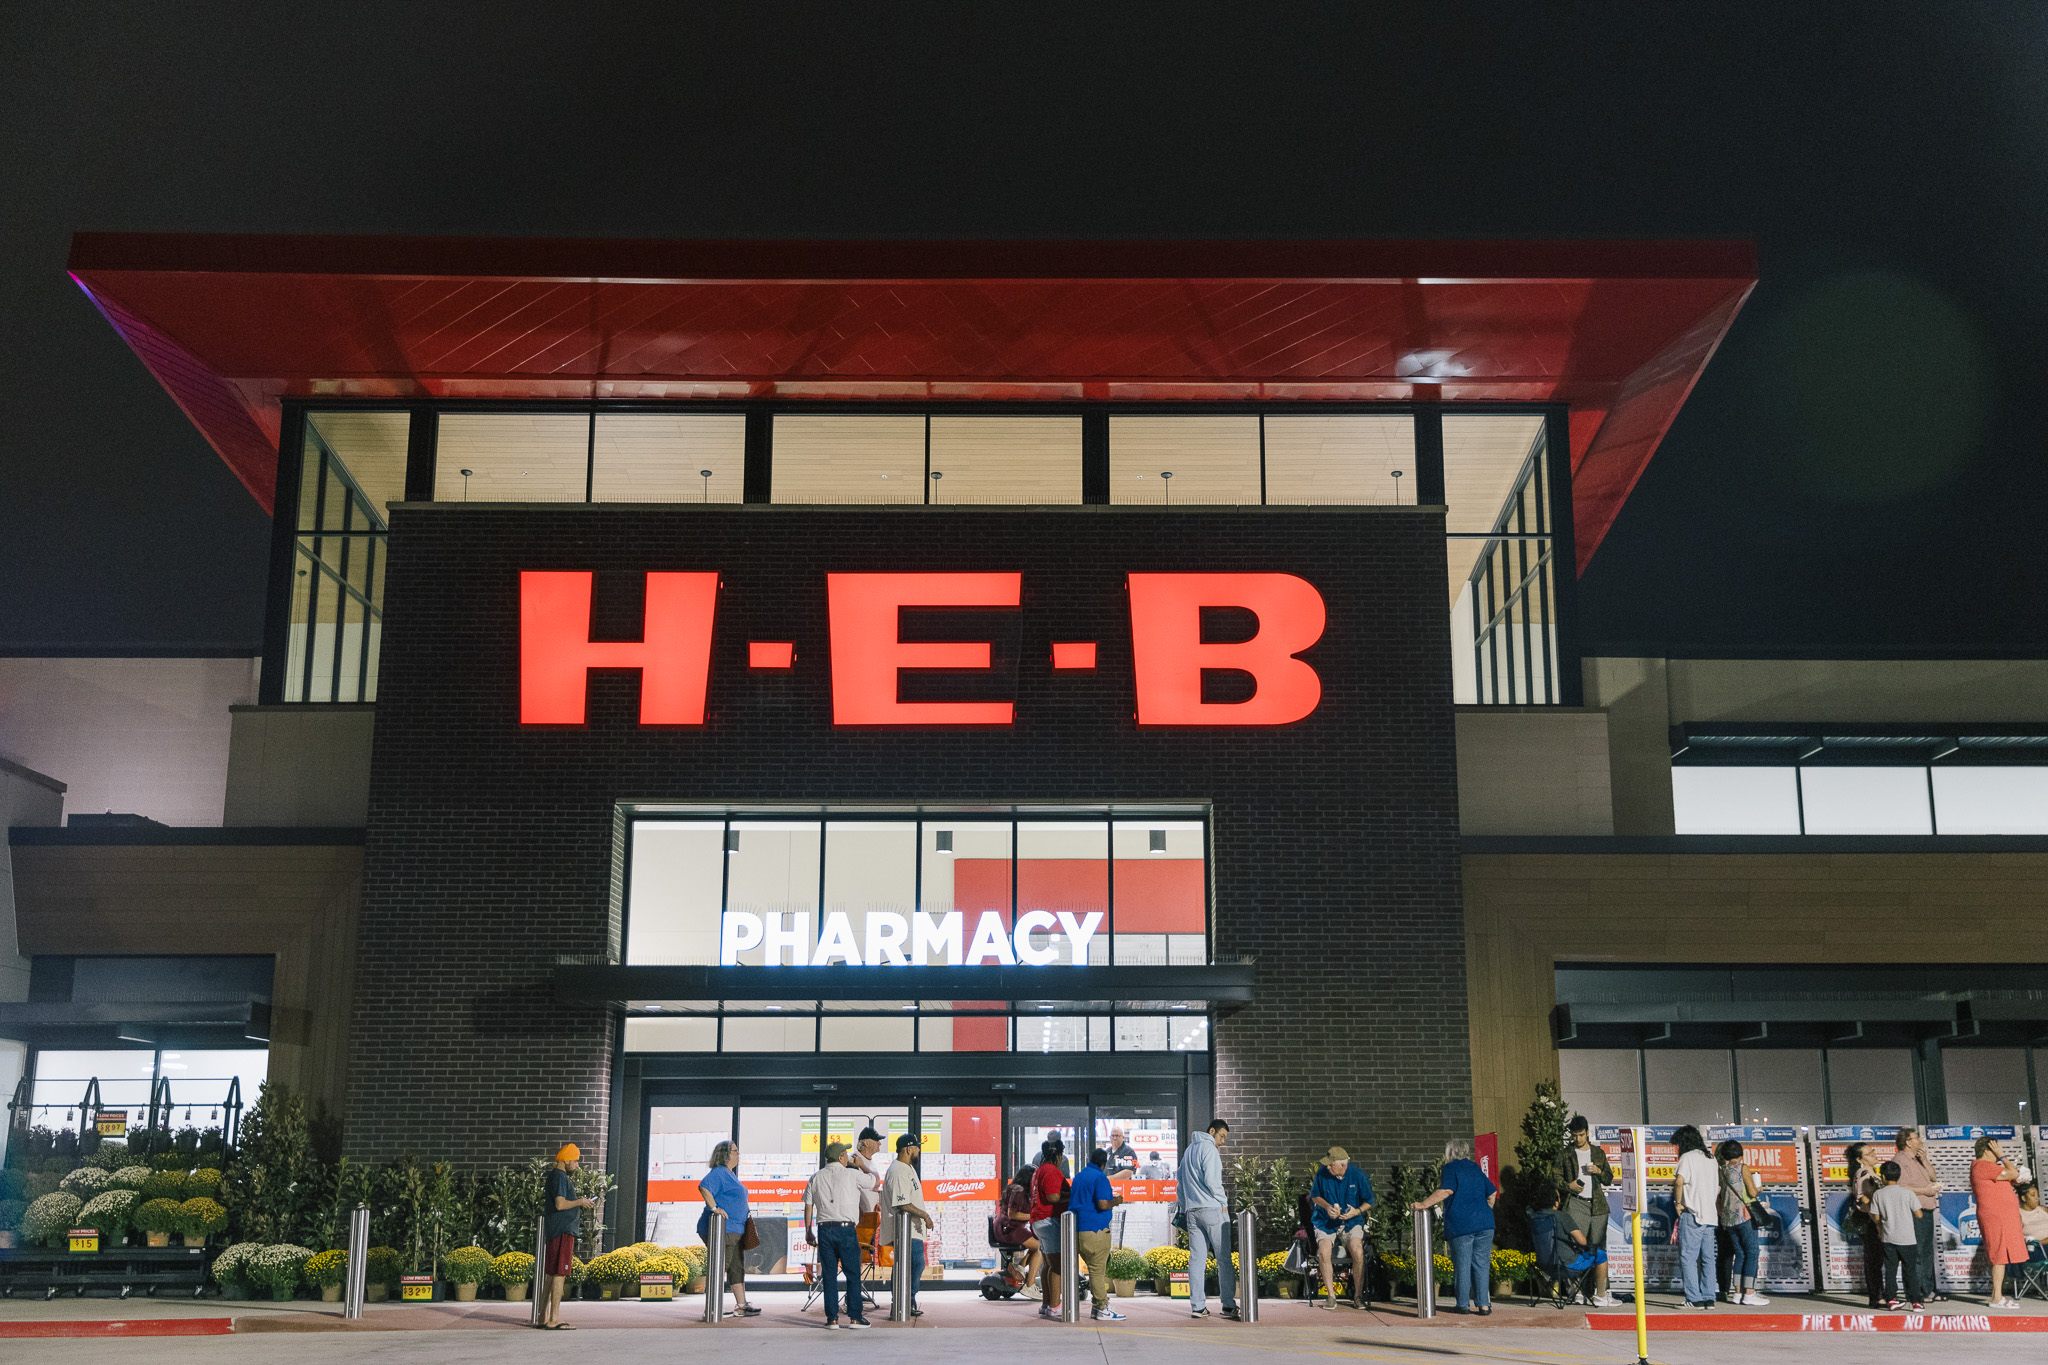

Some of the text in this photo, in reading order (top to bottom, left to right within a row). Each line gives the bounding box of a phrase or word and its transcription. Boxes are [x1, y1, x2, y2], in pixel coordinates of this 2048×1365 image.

[721, 910, 1104, 967] PHARMACY
[1620, 1136, 1633, 1149] STOP
[1651, 1146, 1676, 1154] PURCHASE
[1743, 1149, 1782, 1167] OPANE
[936, 1181, 986, 1194] Welcome
[75, 1239, 92, 1248] $15
[649, 1285, 666, 1296] $15
[1802, 1315, 1991, 1331] FIRE LANE NO PARKING
